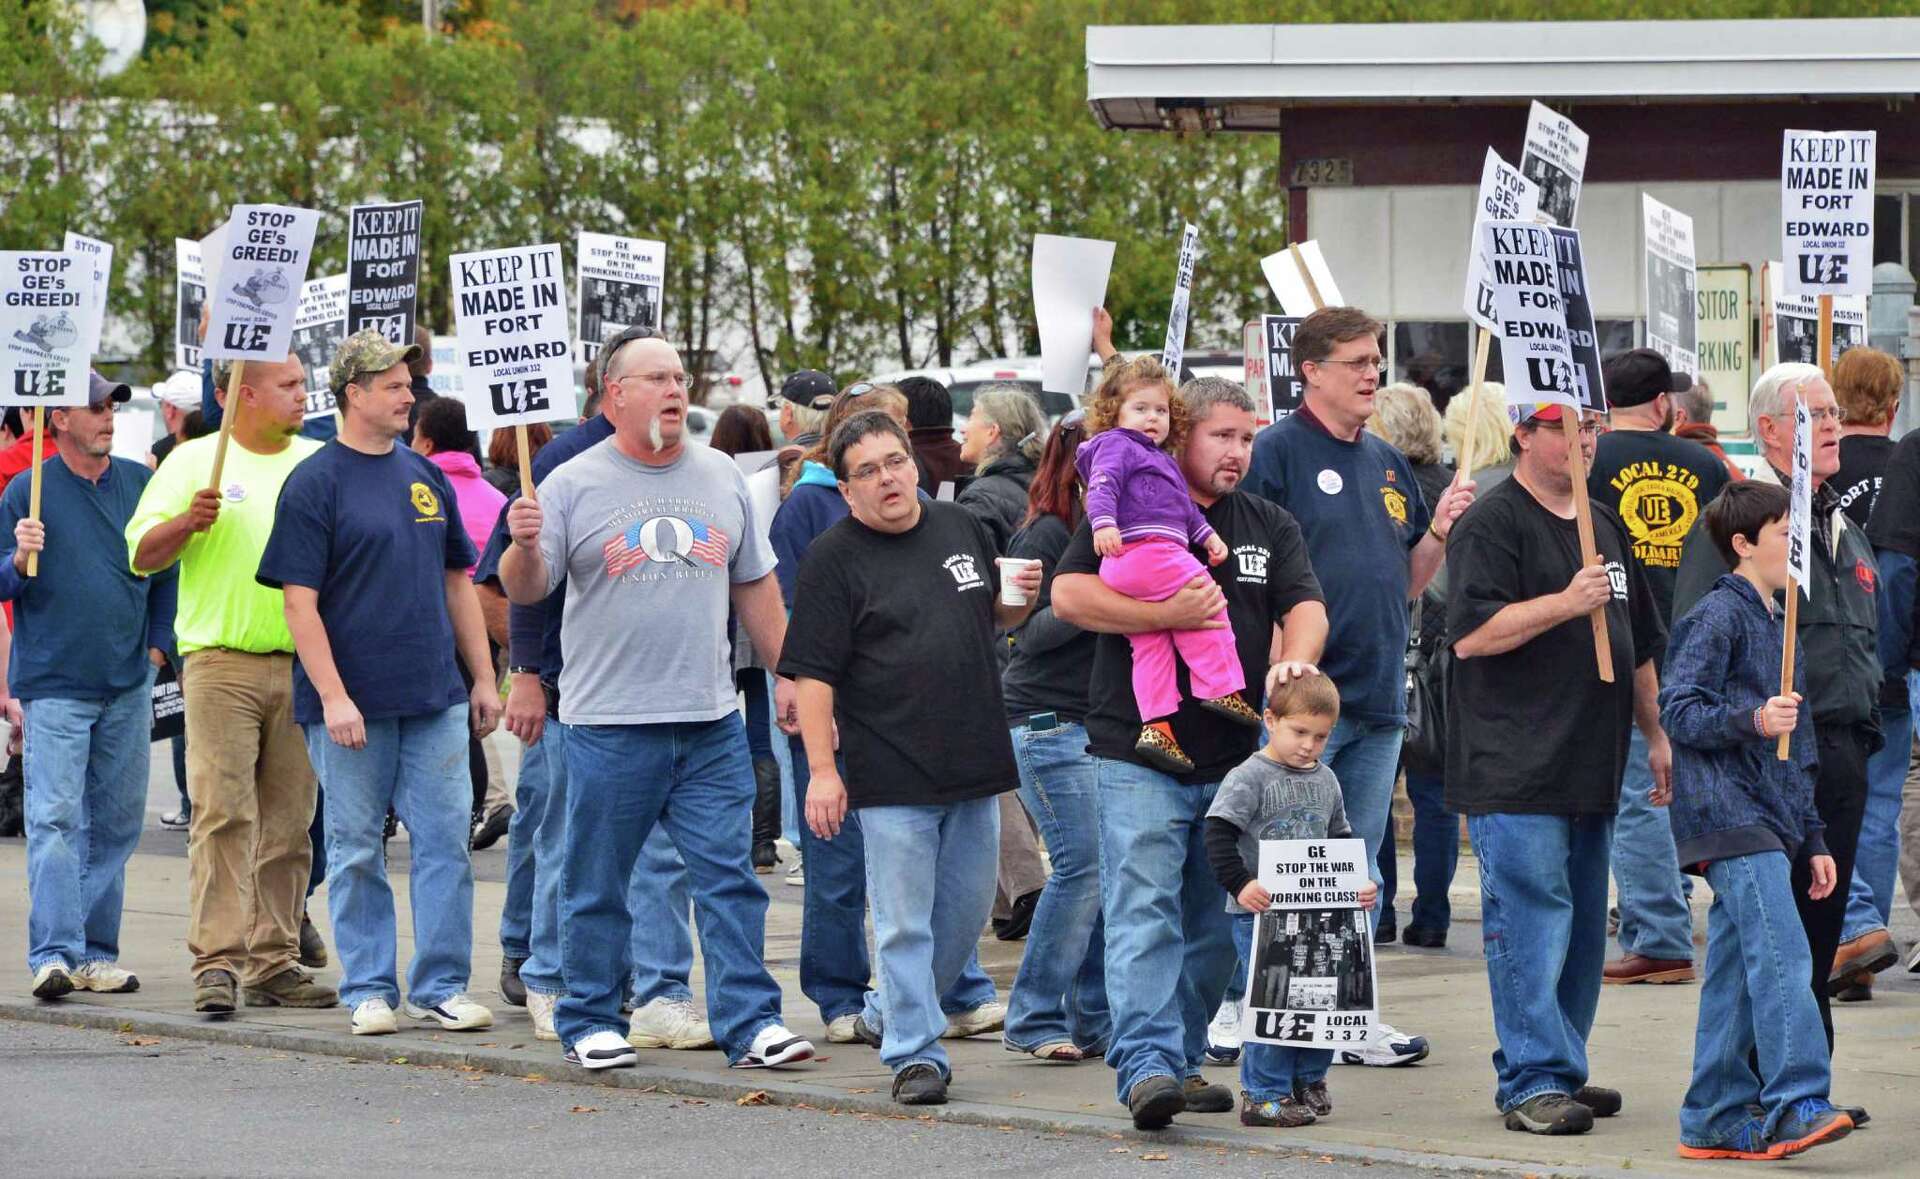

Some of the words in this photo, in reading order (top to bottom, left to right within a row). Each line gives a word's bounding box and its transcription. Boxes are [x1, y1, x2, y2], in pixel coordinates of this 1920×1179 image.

[1790, 138, 1845, 163] KEEP
[1850, 138, 1870, 163] IT
[1495, 164, 1526, 195] STOP
[1787, 168, 1843, 189] MADE
[1848, 168, 1868, 189] IN
[1802, 195, 1853, 210] FORT
[248, 211, 296, 228] STOP
[356, 210, 402, 236] KEEP
[403, 207, 418, 232] IT
[1786, 222, 1870, 237] EDWARD
[248, 229, 287, 245] GE's
[353, 237, 400, 261] MADE
[401, 234, 417, 257] IN
[616, 241, 630, 250] GE
[1492, 227, 1549, 257] KEEP
[232, 246, 299, 264] GREED!
[591, 248, 613, 257] STOP
[18, 258, 71, 273] STOP
[366, 261, 407, 279] FORT
[460, 256, 523, 287] KEEP
[529, 252, 554, 279] IT
[582, 266, 622, 277] WORKING
[1494, 260, 1555, 288] MADE
[1798, 254, 1849, 284] UE
[23, 275, 65, 290] GE's
[309, 284, 325, 293] GE
[6, 292, 80, 307] GREED!
[351, 283, 415, 305] EDWARD
[461, 287, 526, 317] MADE
[532, 282, 559, 309] IN
[1801, 294, 1815, 303] ON
[305, 306, 317, 314] ON
[1697, 290, 1739, 320] SITOR
[1833, 310, 1863, 321] ASS!!!
[485, 314, 543, 336] FORT
[223, 323, 272, 351] UE
[468, 341, 567, 368] EDWARD
[1697, 341, 1742, 372] RKING
[14, 369, 66, 396] UE
[493, 367, 512, 378] LOCAL
[489, 378, 550, 415] UE
[1610, 461, 1663, 492] LOCAL
[1838, 479, 1870, 513] ORT
[1643, 498, 1667, 521] UE
[1232, 544, 1257, 555] LOCAL
[949, 562, 980, 584] UE
[1238, 554, 1267, 577] UE
[1308, 846, 1327, 858] GE
[1276, 862, 1306, 874] STOP
[1309, 862, 1329, 873] THE
[1331, 861, 1355, 872] WAR
[1299, 877, 1315, 888] ON
[1318, 877, 1337, 888] THE
[1255, 1010, 1316, 1042] UE
[1326, 1015, 1369, 1026] LOCAL
